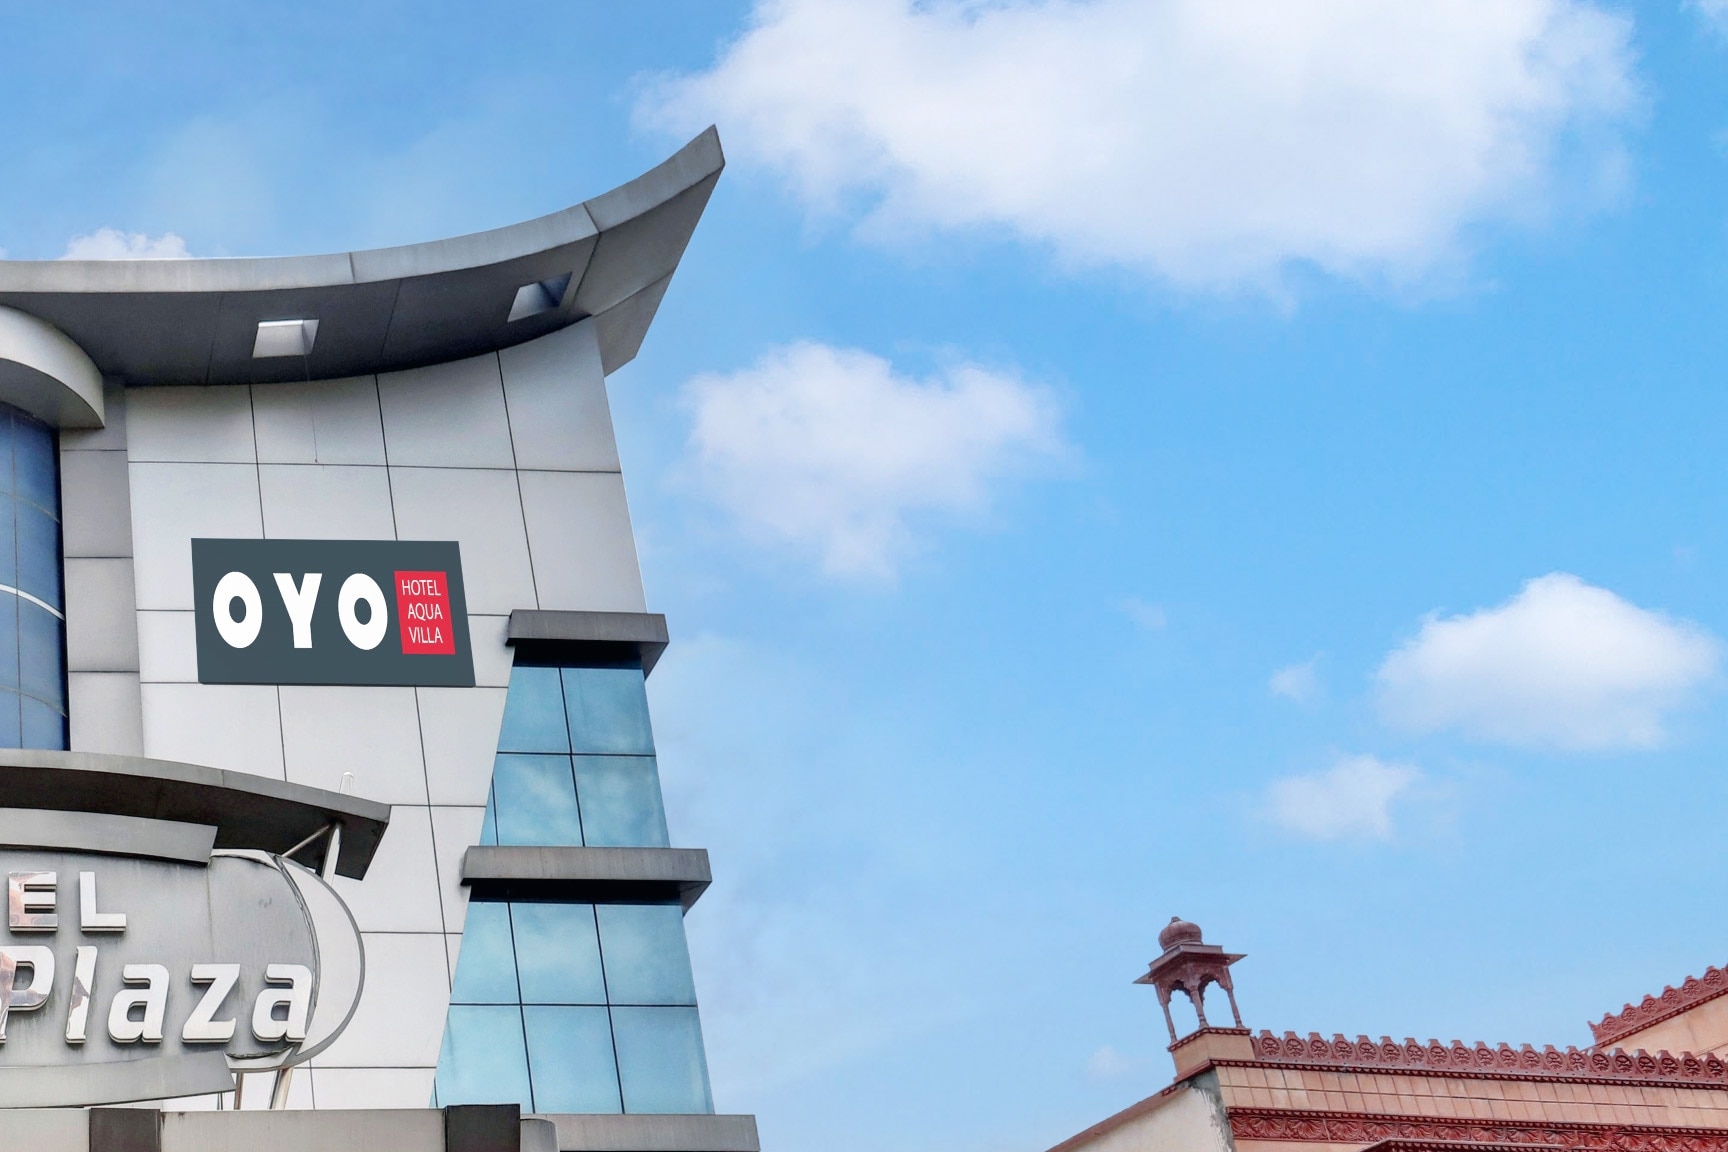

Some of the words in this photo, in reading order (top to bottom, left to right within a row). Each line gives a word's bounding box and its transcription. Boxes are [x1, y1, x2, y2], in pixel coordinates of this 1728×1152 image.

[401, 579, 441, 597] HOTEL
[213, 571, 388, 650] OYO
[407, 602, 443, 621] AQUA
[408, 626, 444, 644] VILLA
